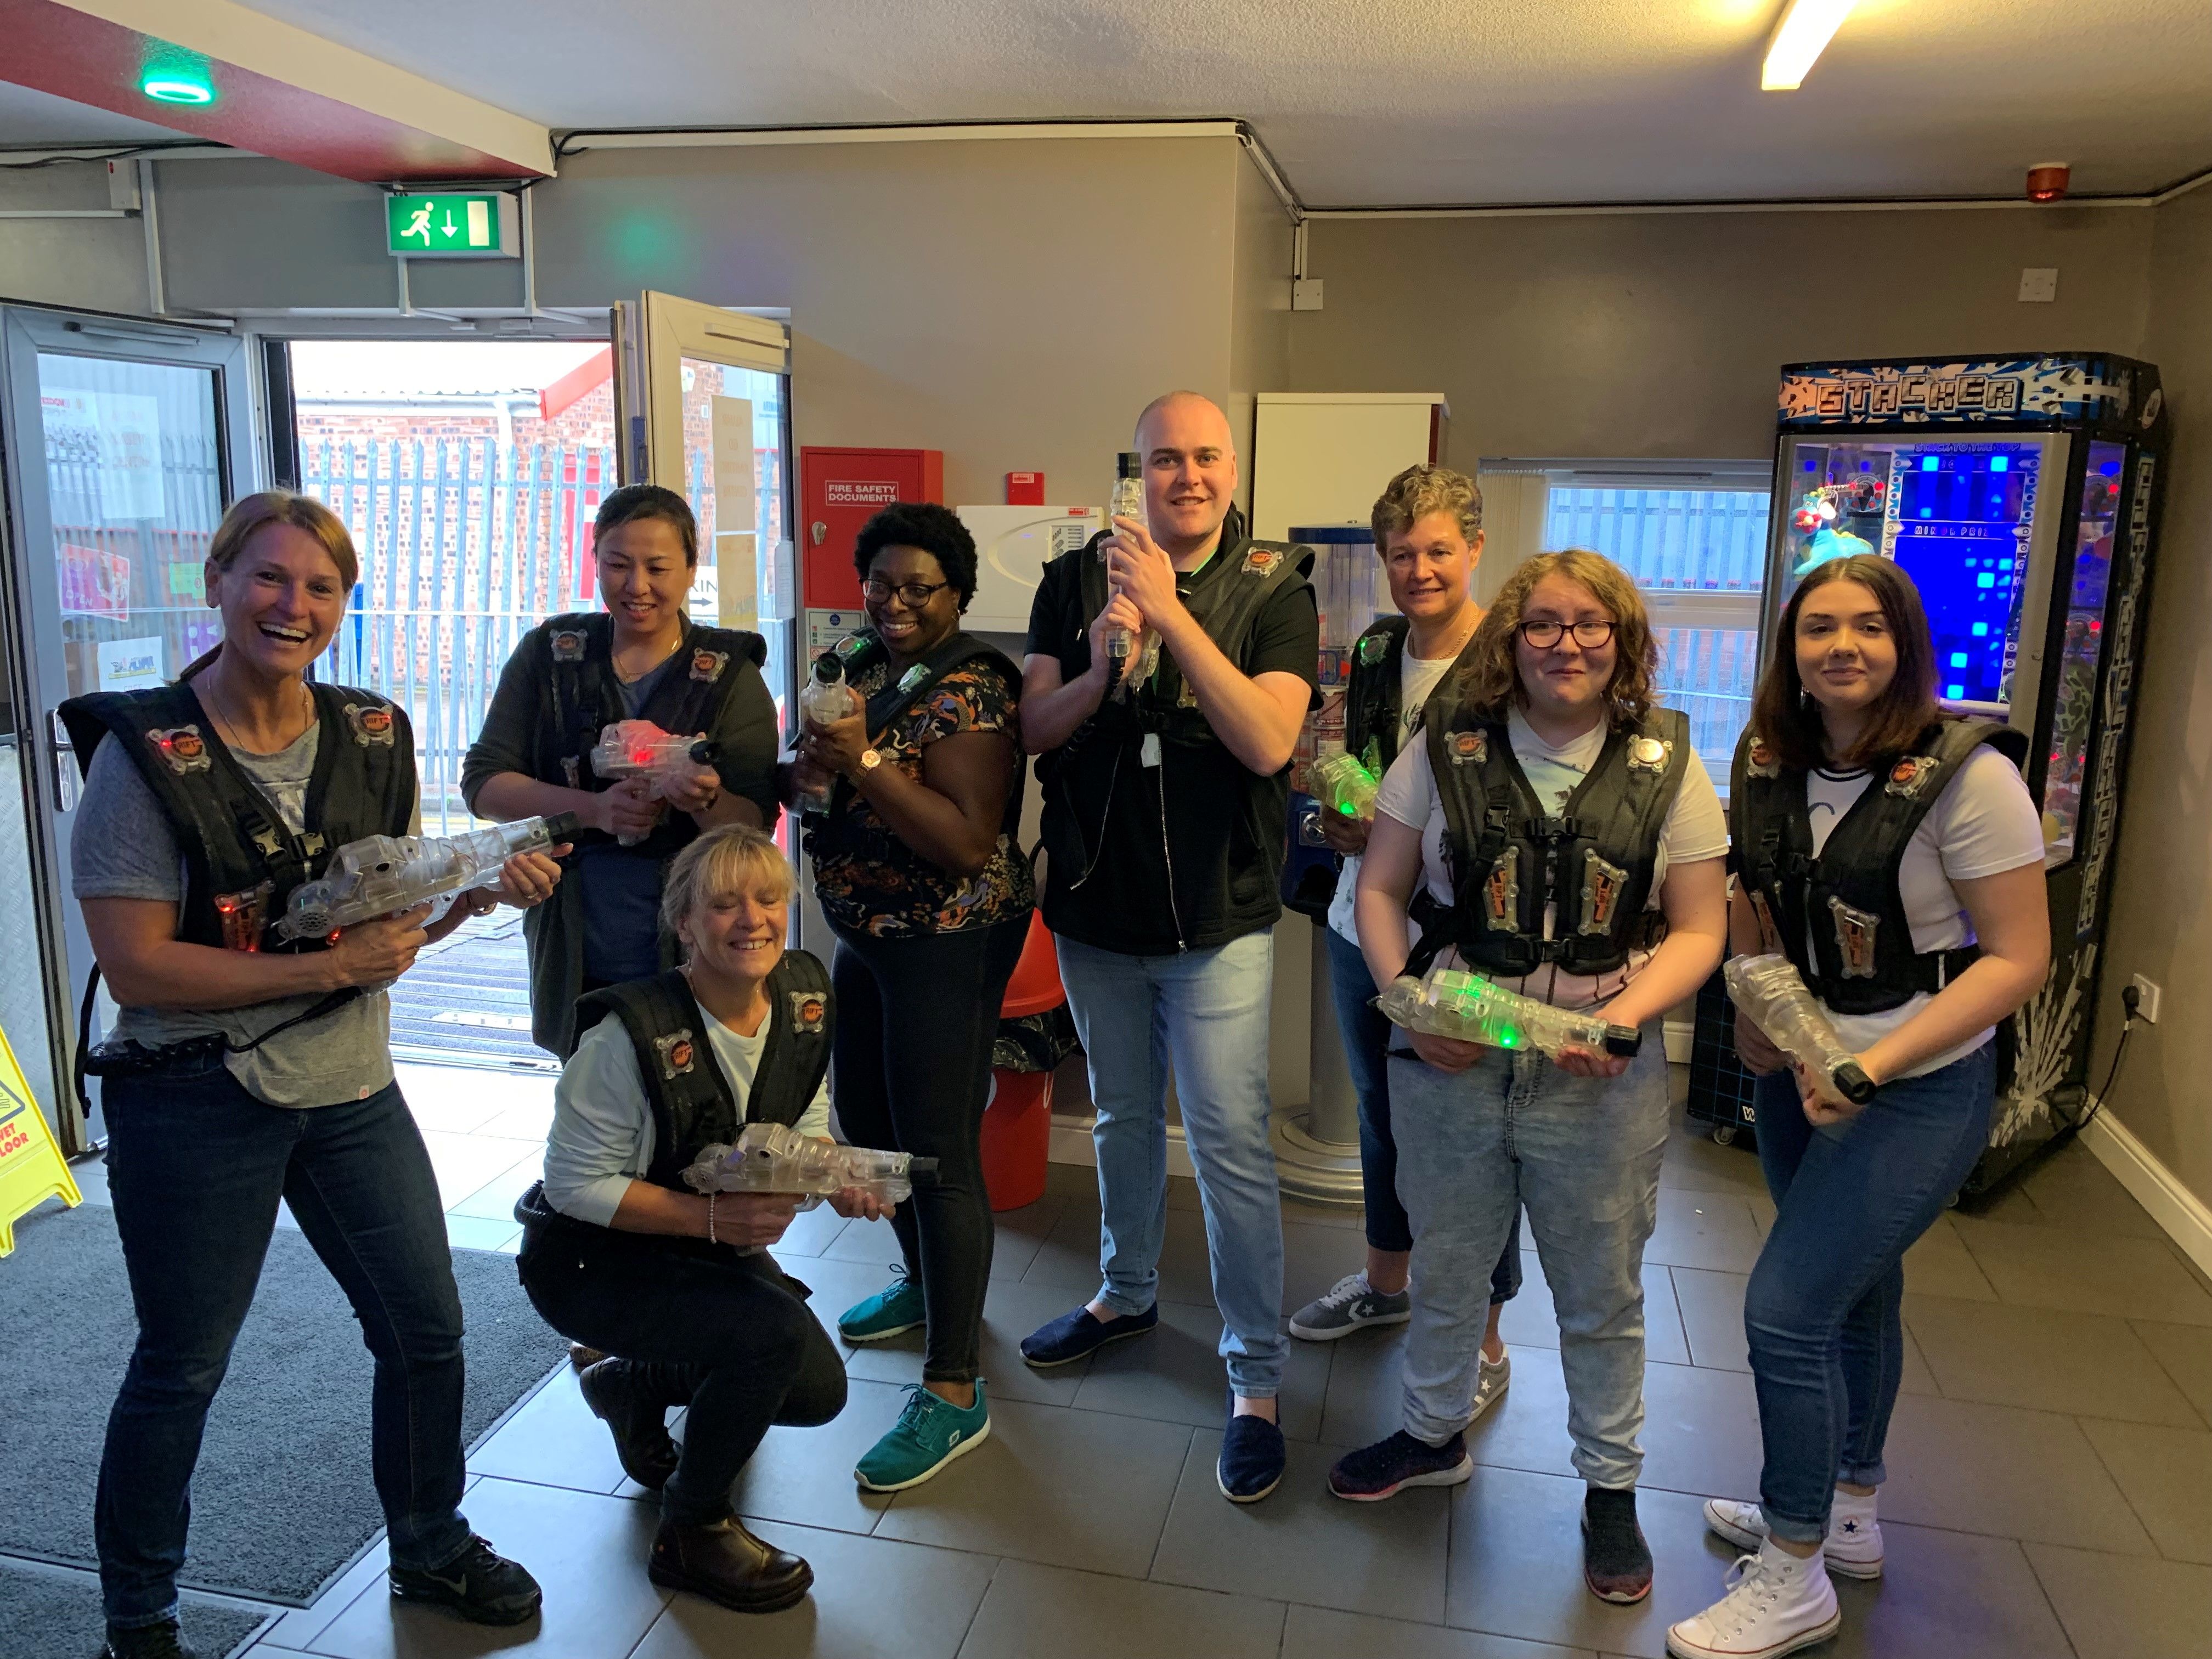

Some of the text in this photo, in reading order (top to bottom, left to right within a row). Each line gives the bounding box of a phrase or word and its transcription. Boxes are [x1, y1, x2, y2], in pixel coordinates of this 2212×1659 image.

[1819, 375, 2014, 413] STACKER
[1915, 443, 2020, 453] STACK TO THE TOP
[855, 485, 896, 493] SAFETY
[828, 493, 896, 502] DOCUMENTS
